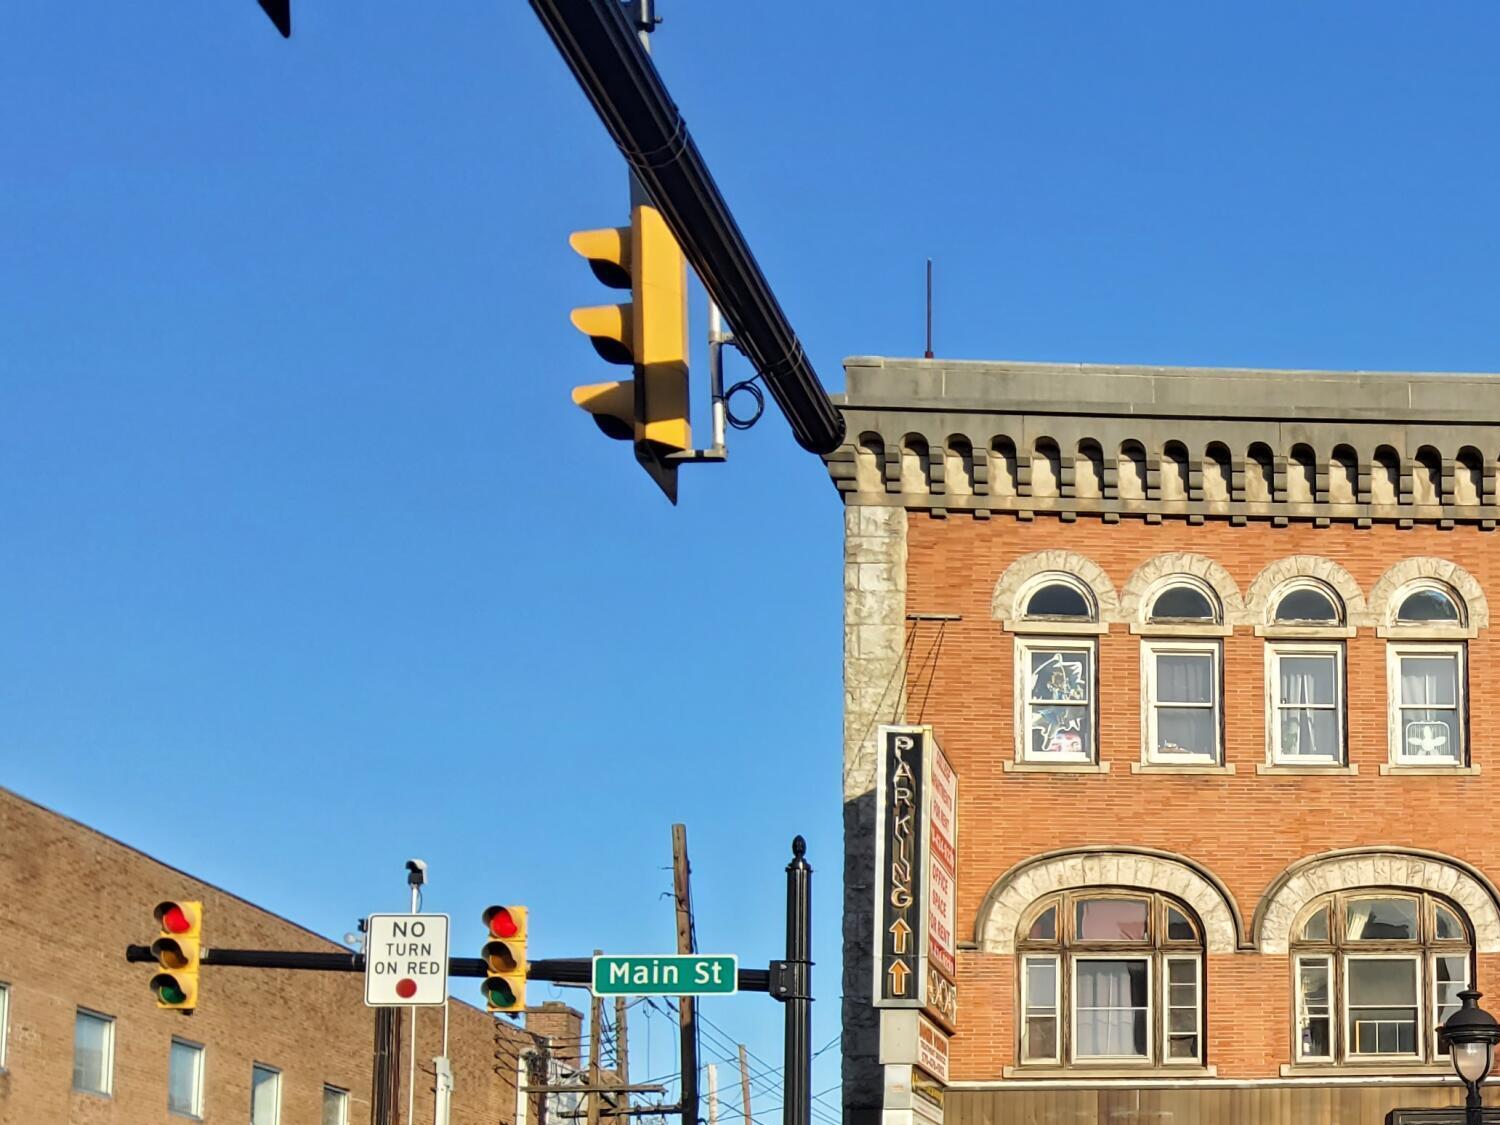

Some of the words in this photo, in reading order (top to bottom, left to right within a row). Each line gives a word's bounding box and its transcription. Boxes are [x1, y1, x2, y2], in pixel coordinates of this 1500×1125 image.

[891, 736, 914, 908] PARKING
[932, 863, 948, 895] OFFICE
[932, 889, 947, 917] SPACE
[392, 921, 426, 938] NO
[937, 918, 951, 946] RENT
[386, 943, 432, 957] TURN
[374, 962, 398, 975] ON
[406, 961, 440, 975] RED
[609, 961, 670, 985] Main
[694, 961, 722, 984] St
